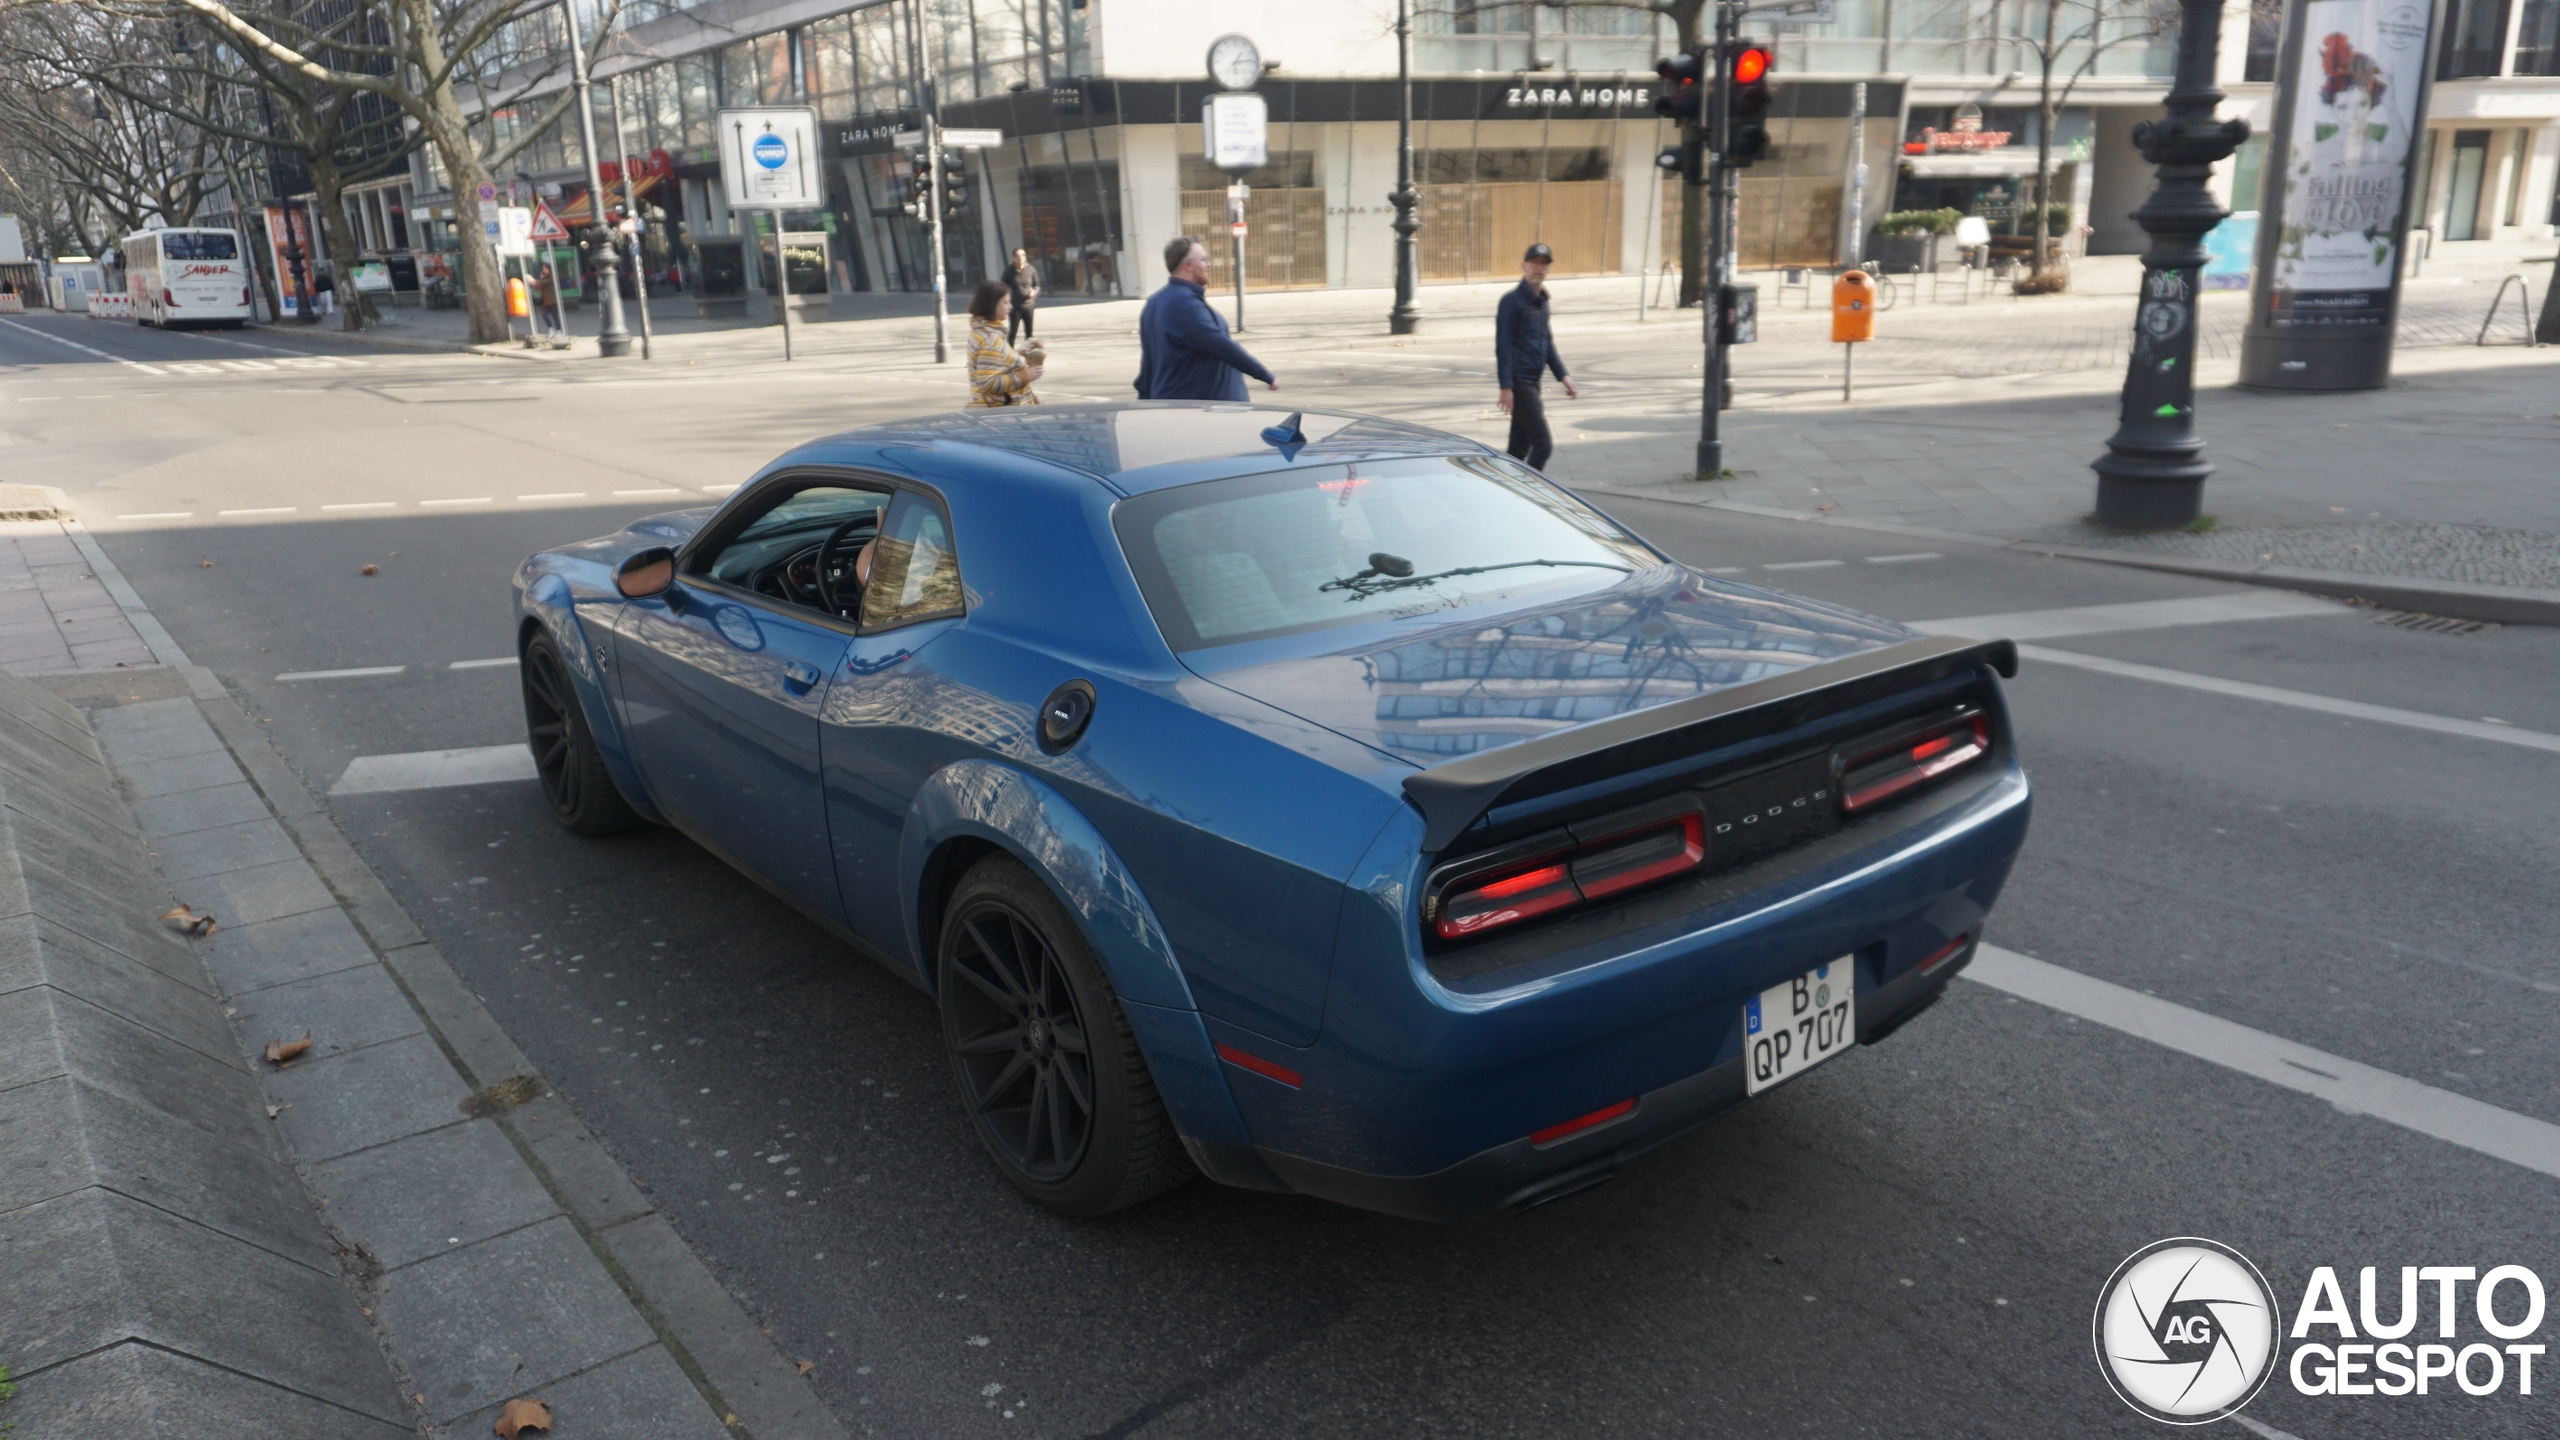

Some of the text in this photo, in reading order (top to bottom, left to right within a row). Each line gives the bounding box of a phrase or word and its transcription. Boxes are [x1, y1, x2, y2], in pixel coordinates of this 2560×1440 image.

[1507, 88, 1650, 105] ZARA HOME
[841, 129, 870, 144] ZARA
[873, 124, 904, 140] HOME
[1328, 206, 1366, 214] ZARA
[179, 264, 232, 279] SANDER
[1055, 709, 1069, 719] FUEL
[1716, 790, 1827, 834] DODGE
[1791, 972, 1810, 1017] B
[1750, 1015, 1758, 1029] D
[1754, 1001, 1849, 1082] QP 707
